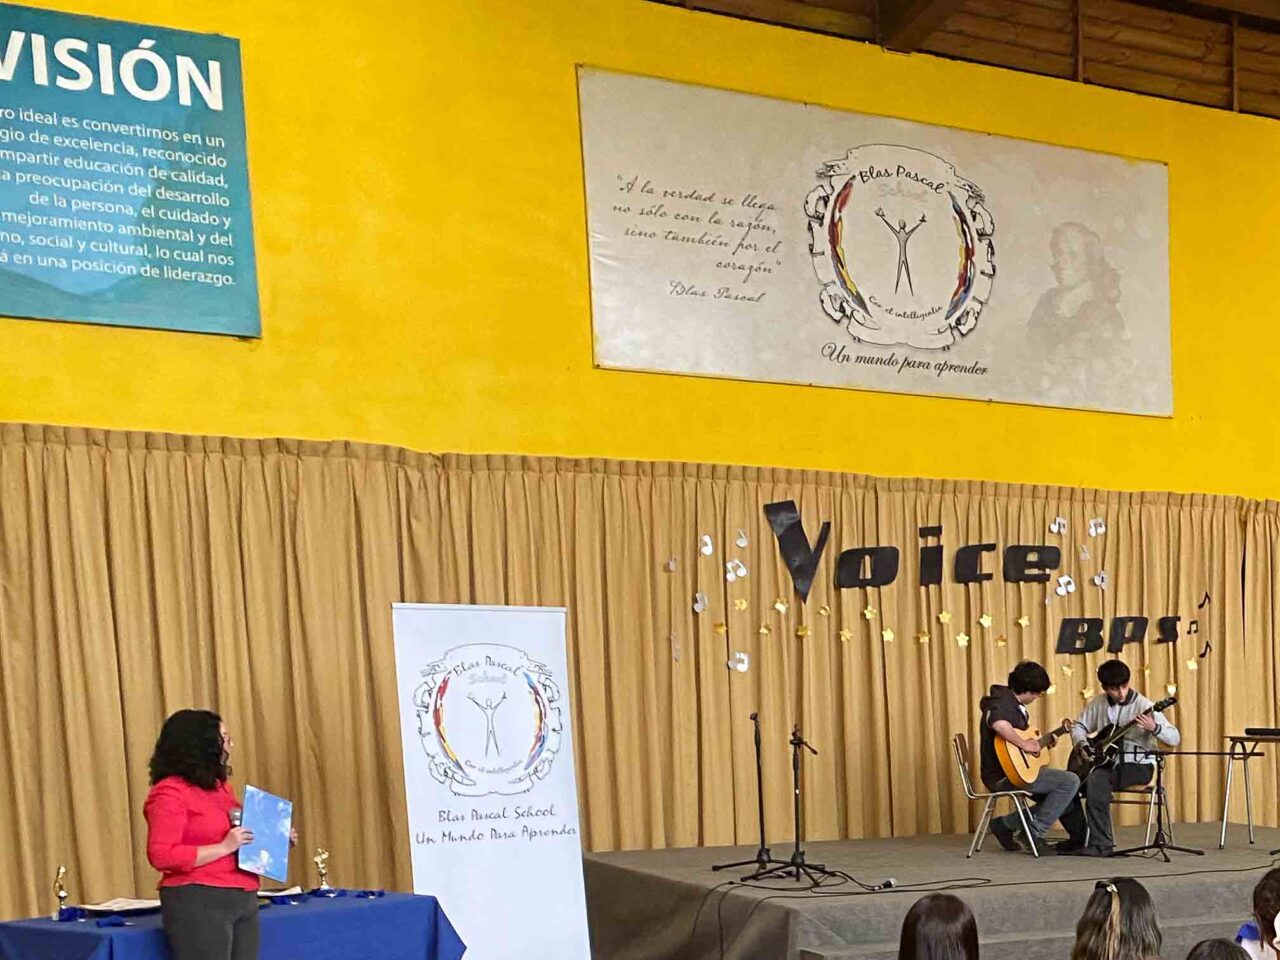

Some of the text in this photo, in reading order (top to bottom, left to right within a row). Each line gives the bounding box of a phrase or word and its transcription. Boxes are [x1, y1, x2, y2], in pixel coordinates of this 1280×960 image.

[0, 30, 223, 111] VISIÓN
[19, 107, 58, 126] ideal
[61, 116, 79, 128] es
[82, 119, 180, 142] convertirnos
[182, 132, 202, 145] en
[205, 136, 225, 148] un
[29, 129, 50, 144] de
[53, 135, 138, 158] excelencia,
[142, 147, 227, 168] reconocido
[16, 172, 124, 195] preocupación
[128, 182, 152, 197] del
[155, 186, 230, 207] desarrollo
[63, 156, 144, 177] educación
[148, 165, 168, 180] de
[170, 169, 229, 189] calidad,
[858, 164, 945, 194] Blas Pascal
[29, 190, 232, 230] de la persona, el cuidado y
[640, 180, 655, 195] la
[662, 189, 717, 203] verdad
[721, 197, 735, 206] se
[741, 193, 778, 221] llega
[1, 210, 233, 246] mejoramiento ambiental y del
[612, 203, 777, 236] no sólo con la razón,
[29, 234, 73, 248] social
[77, 239, 86, 253] y
[90, 240, 152, 259] cultural,
[155, 244, 170, 259] lo
[173, 249, 204, 262] cual
[207, 253, 235, 266] nos
[624, 224, 782, 256] sino también por el
[13, 253, 33, 265] en
[37, 255, 68, 269] una
[140, 263, 160, 278] de
[163, 264, 236, 287] liderazgo.
[669, 280, 766, 303] Blas Pascal
[821, 342, 989, 377] Un mundo para aprender
[763, 499, 1061, 605] Voice
[452, 655, 524, 677] Blas Pascal
[438, 804, 557, 823] Blas Pascal School
[415, 823, 578, 845] Un Mundo Para Aprender
